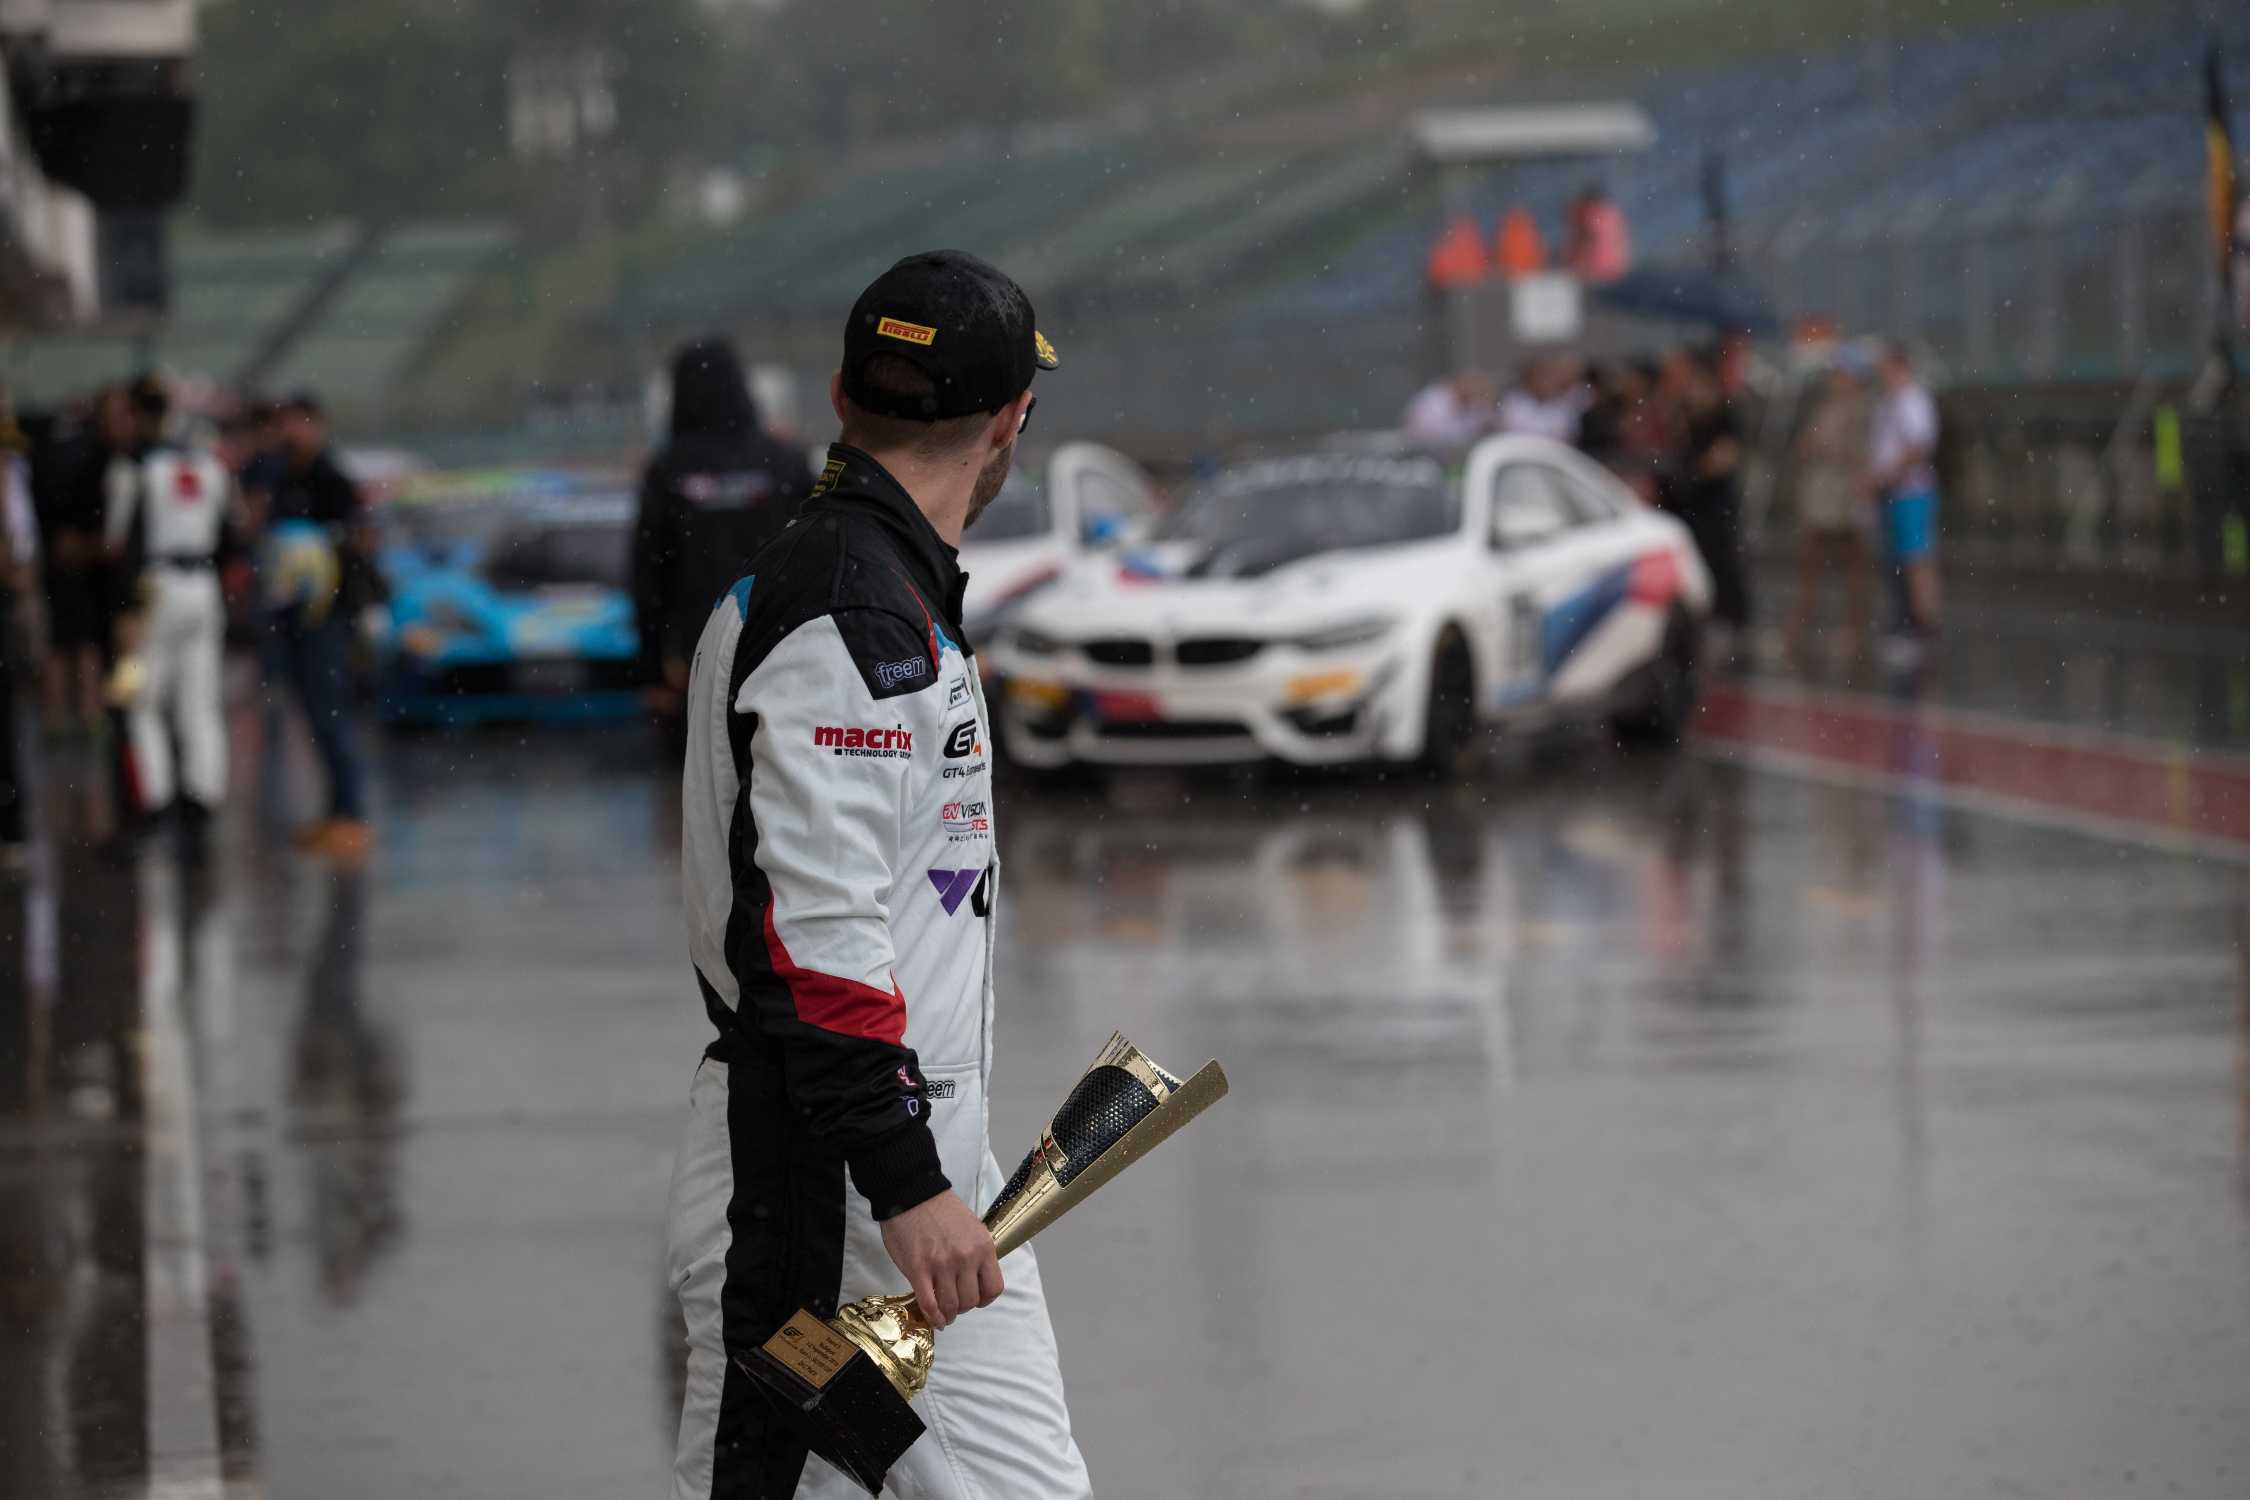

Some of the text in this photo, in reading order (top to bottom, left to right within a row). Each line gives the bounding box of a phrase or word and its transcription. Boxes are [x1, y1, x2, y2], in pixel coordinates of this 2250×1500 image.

[882, 320, 930, 341] PIRELLI
[875, 655, 926, 688] freem
[814, 724, 912, 752] macrix
[844, 748, 898, 759] TECHNOLOGY
[943, 766, 966, 779] GT4
[927, 1080, 956, 1099] eem
